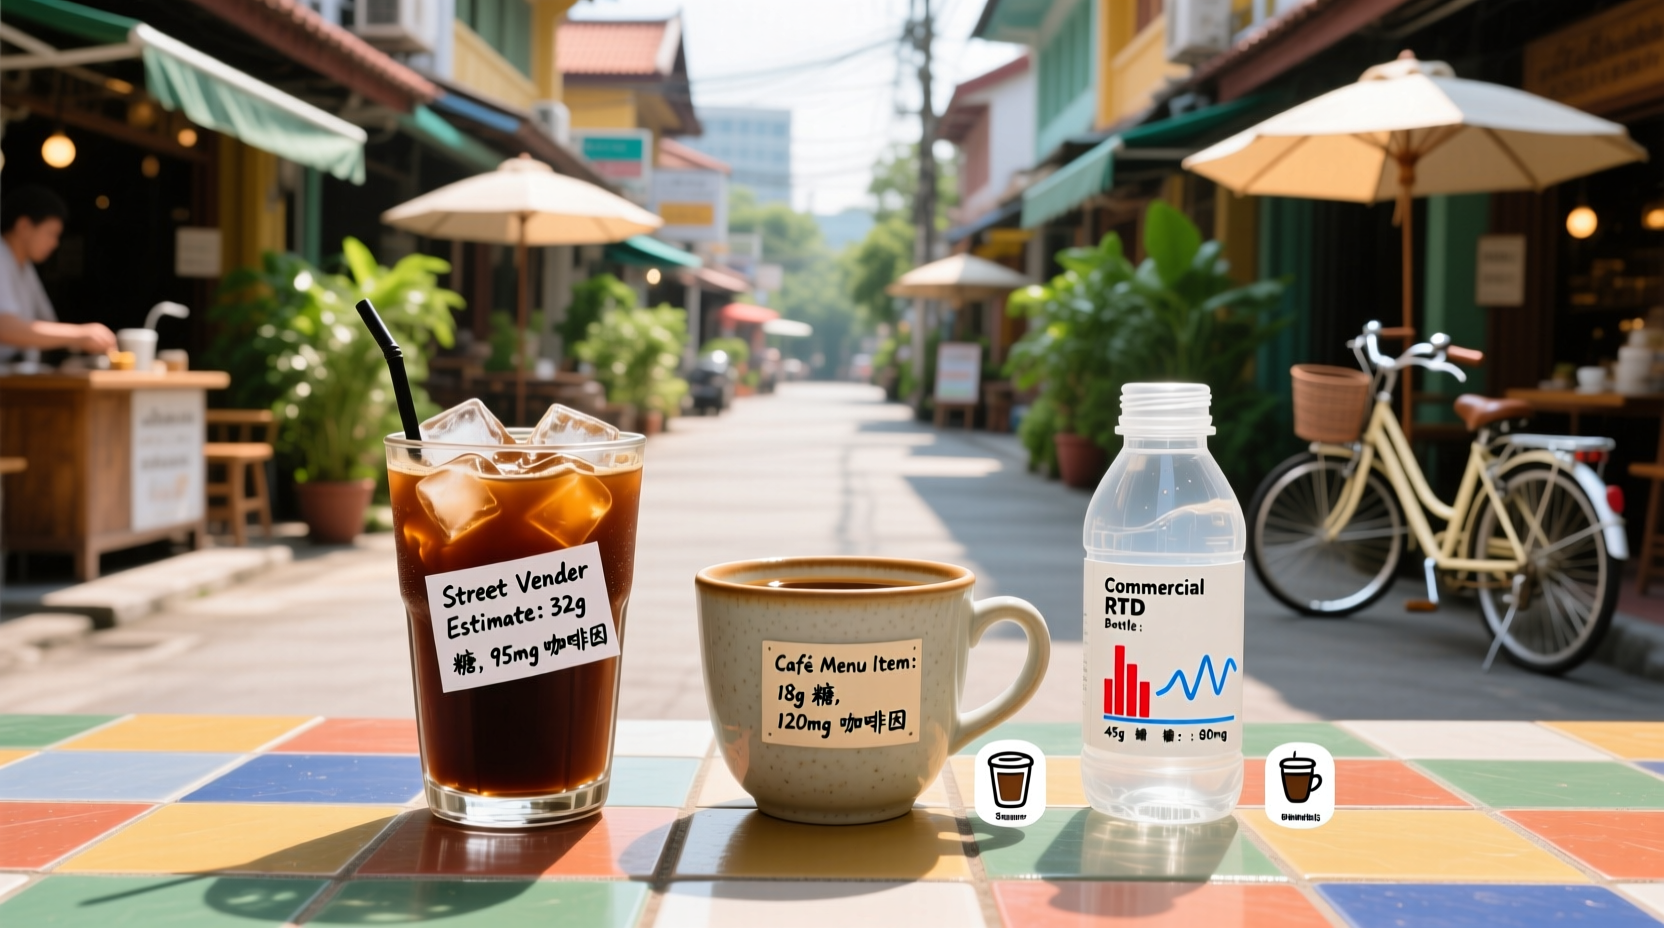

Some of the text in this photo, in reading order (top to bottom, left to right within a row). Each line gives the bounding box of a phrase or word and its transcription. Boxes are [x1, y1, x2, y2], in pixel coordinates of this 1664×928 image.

[442, 561, 588, 609] Street Vender
[1104, 577, 1205, 596] Commercial
[447, 595, 586, 639] Estimate: 32g
[1105, 596, 1146, 617] RTD
[490, 645, 539, 667] 95mg
[775, 653, 916, 675] Café Menu Item:
[778, 683, 805, 709] 18g
[778, 712, 831, 739] 120mg
[1103, 726, 1125, 743] 45g
